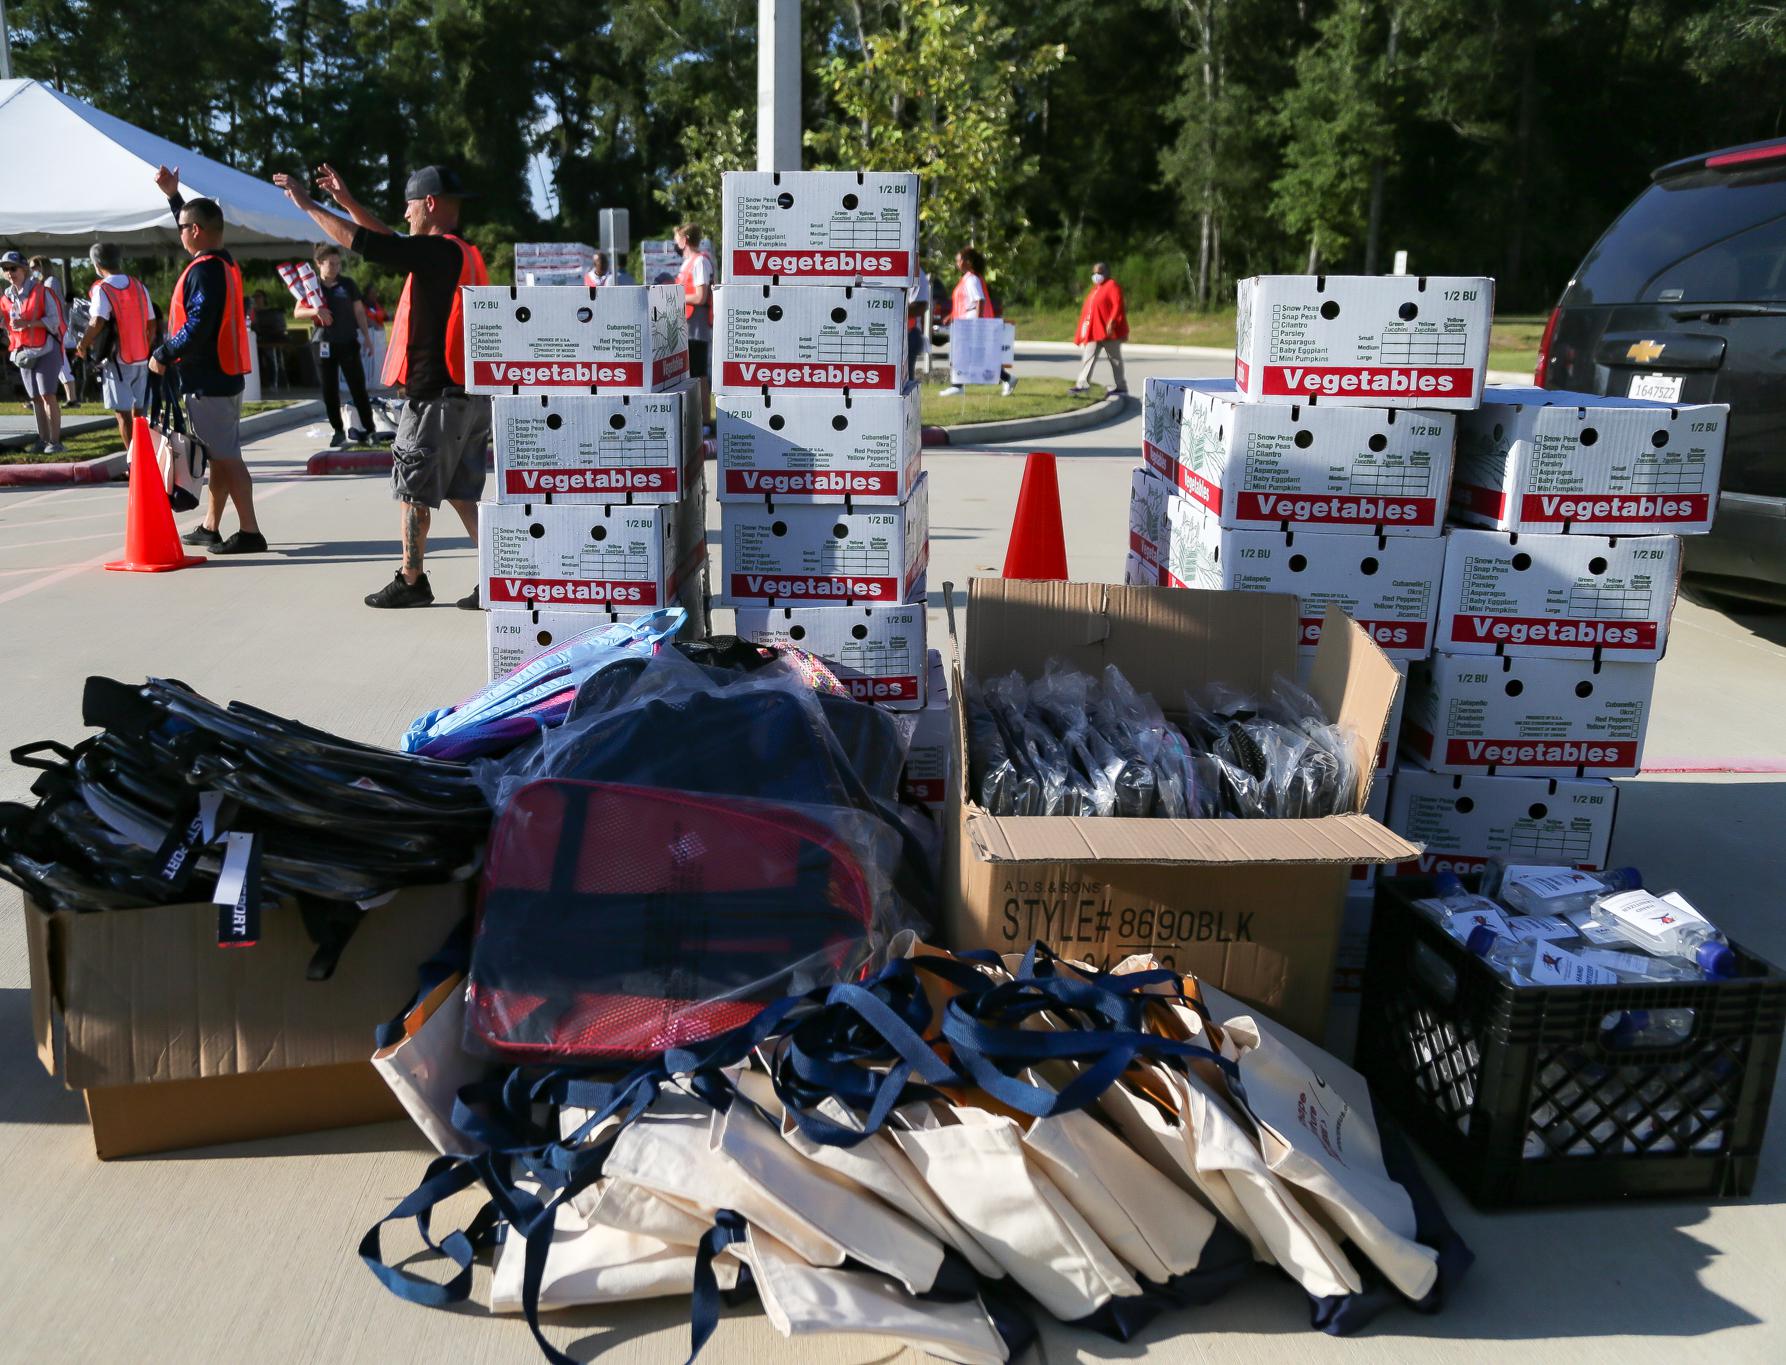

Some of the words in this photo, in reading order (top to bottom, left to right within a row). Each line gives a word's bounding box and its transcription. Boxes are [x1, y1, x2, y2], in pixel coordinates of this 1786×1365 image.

[895, 186, 906, 194] BU
[750, 252, 892, 274] Vegetables
[883, 301, 894, 309] BU
[1444, 291, 1459, 300] 1/2
[1462, 291, 1477, 300] BU
[490, 363, 626, 384] Vegetables
[740, 364, 879, 385] Vegetables
[1283, 369, 1454, 393] Vegetables
[1411, 426, 1425, 436] 1/2
[1428, 427, 1441, 436] BU
[1690, 423, 1704, 432] 1/2
[1705, 423, 1717, 432] BU
[522, 470, 661, 491] Vegetables
[743, 472, 881, 492] Vegetables
[1269, 483, 1302, 491] Pumpkins
[1272, 475, 1301, 483] Eggplant
[1257, 495, 1417, 520] Vegetables
[1541, 496, 1692, 520] Vegetables
[1240, 549, 1255, 557] 1/2
[1258, 550, 1270, 558] BU
[1633, 551, 1648, 559] 1/2
[1650, 551, 1664, 559] BU
[505, 580, 640, 600] Vegetables
[747, 576, 882, 596] Vegetables
[1485, 605, 1519, 614] Pumpkins
[1488, 598, 1518, 606] Eggplant
[1473, 618, 1638, 643] Vegetables
[1457, 674, 1472, 682] 1/2
[1475, 674, 1488, 683] BU
[1467, 742, 1618, 762] Vegetables
[1002, 898, 1112, 942] STYLE#
[1118, 908, 1254, 942] 8690BLK
